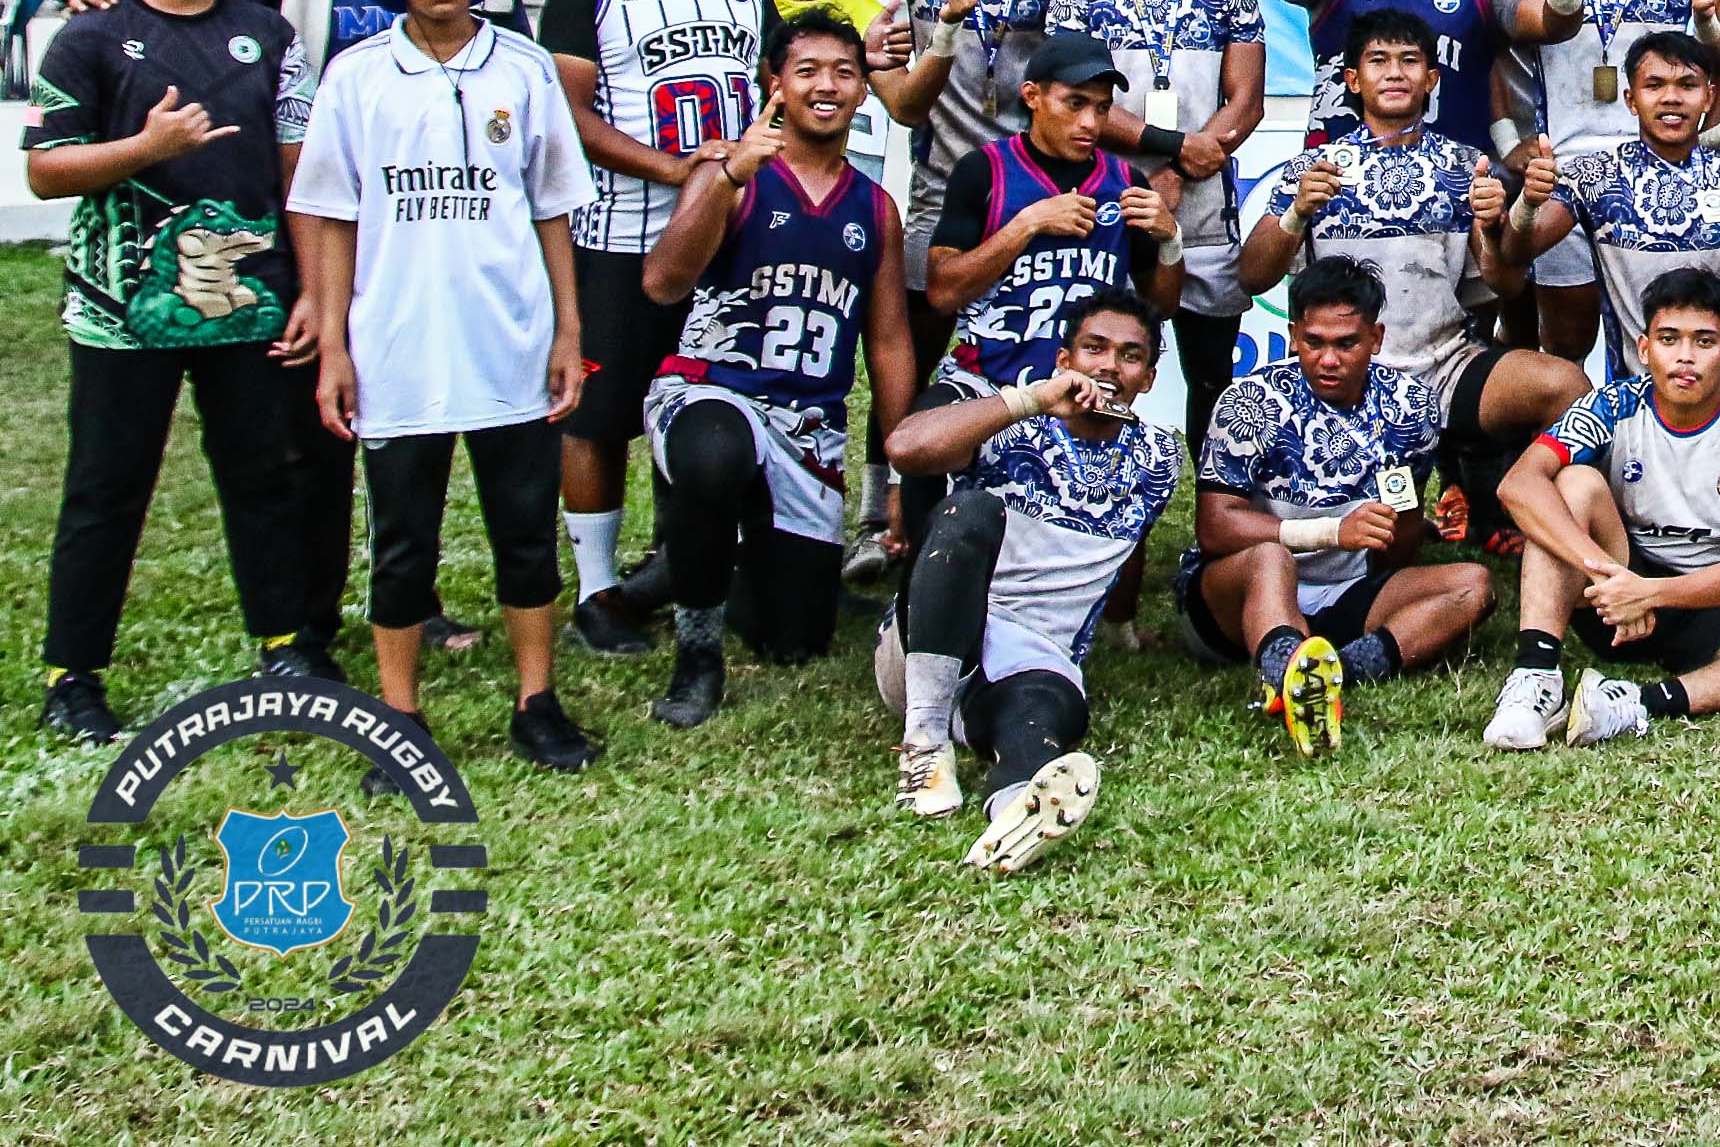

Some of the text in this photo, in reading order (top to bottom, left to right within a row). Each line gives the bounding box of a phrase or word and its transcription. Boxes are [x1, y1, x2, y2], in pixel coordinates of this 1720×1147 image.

[644, 23, 757, 73] SSTMI
[395, 195, 491, 222] FLY BETTER
[750, 263, 859, 319] SSTMI
[1012, 247, 1118, 287] SSTMI
[760, 305, 838, 379] 23
